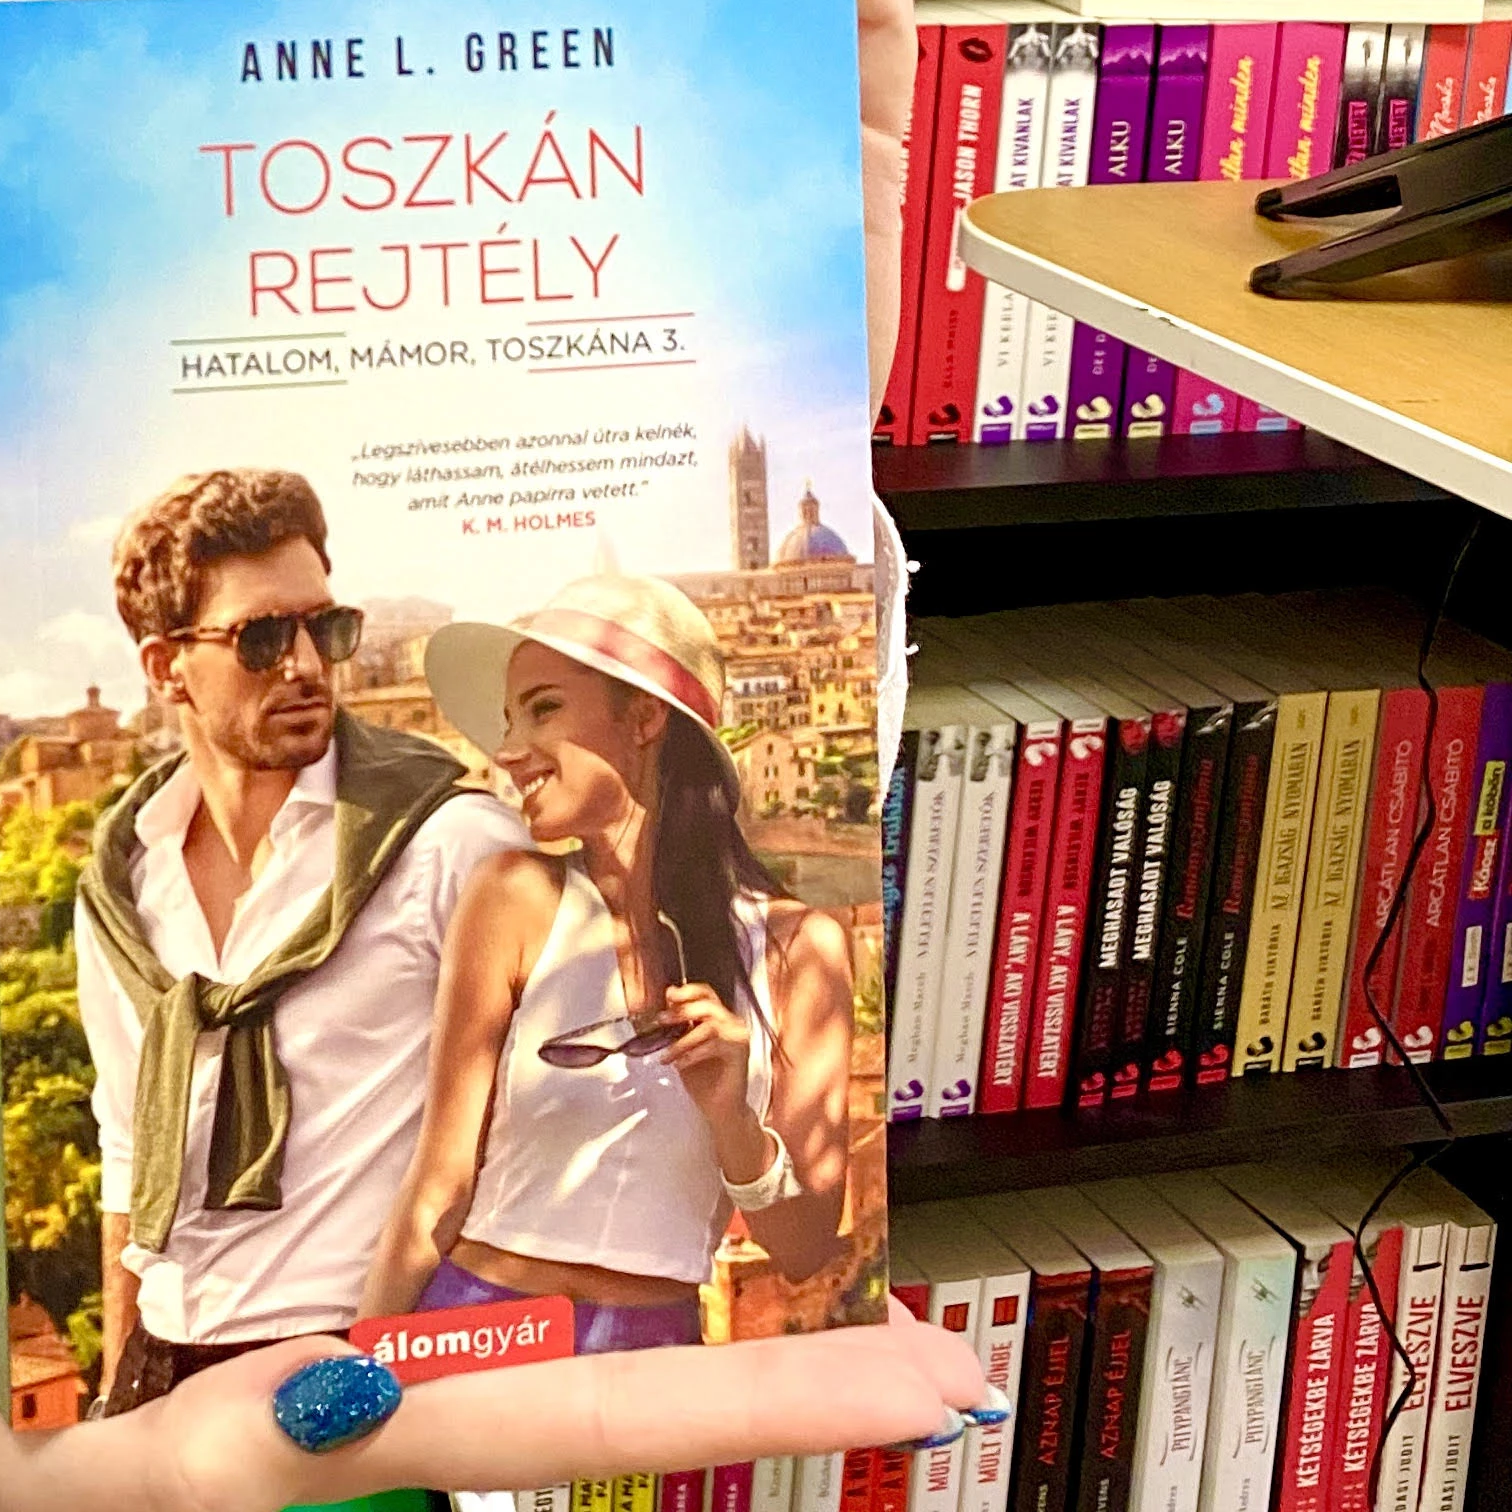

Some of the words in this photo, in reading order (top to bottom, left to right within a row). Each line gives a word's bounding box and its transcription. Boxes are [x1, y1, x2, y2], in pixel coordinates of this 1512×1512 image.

[241, 38, 365, 83] ANNE
[396, 35, 435, 76] L.
[466, 27, 615, 73] GREEN
[959, 84, 983, 142] THORN
[1229, 55, 1254, 134] minden
[1298, 55, 1321, 132] minden
[199, 110, 644, 218] TOSZKÁN
[952, 145, 977, 204] JASON
[1108, 121, 1131, 177] ALKU
[1165, 120, 1186, 175] ALKU
[248, 222, 620, 317] REJTÉLY
[180, 348, 341, 379] HATALOM,
[349, 338, 477, 371] MÁMOR,
[486, 327, 652, 364] TOSZKÁNA
[662, 327, 686, 354] 3.
[515, 430, 589, 450] azonnal
[593, 428, 630, 444] útra
[635, 423, 697, 441] kelnék,
[352, 470, 400, 489] hogy
[405, 464, 504, 484] láthassam,
[510, 458, 614, 477] átélhessem
[619, 450, 698, 469] mindazt,
[407, 496, 450, 511] amit
[455, 492, 504, 508] Anne
[509, 487, 576, 508] papírra
[462, 518, 480, 535] K.
[486, 517, 508, 533] M.
[514, 511, 596, 531] HOLMES
[1098, 868, 1129, 969] MEGHASADT
[1132, 860, 1162, 960] MEGHASADT
[373, 1315, 551, 1364] álomgyár
[1045, 1336, 1071, 1386] ÉJJEL
[1104, 1330, 1132, 1380] ÉJJEL
[1308, 1313, 1335, 1372] ZÁRVA
[1401, 1294, 1436, 1412] ELVESZVE
[1445, 1295, 1485, 1413] ELVESZVE
[1037, 1392, 1063, 1466] AZNAP
[1100, 1386, 1125, 1459] AZNAP
[1296, 1375, 1329, 1488] KÉTSÉGEKBE
[1400, 1435, 1414, 1472] JUDIT
[1446, 1435, 1460, 1472] JUDIT
